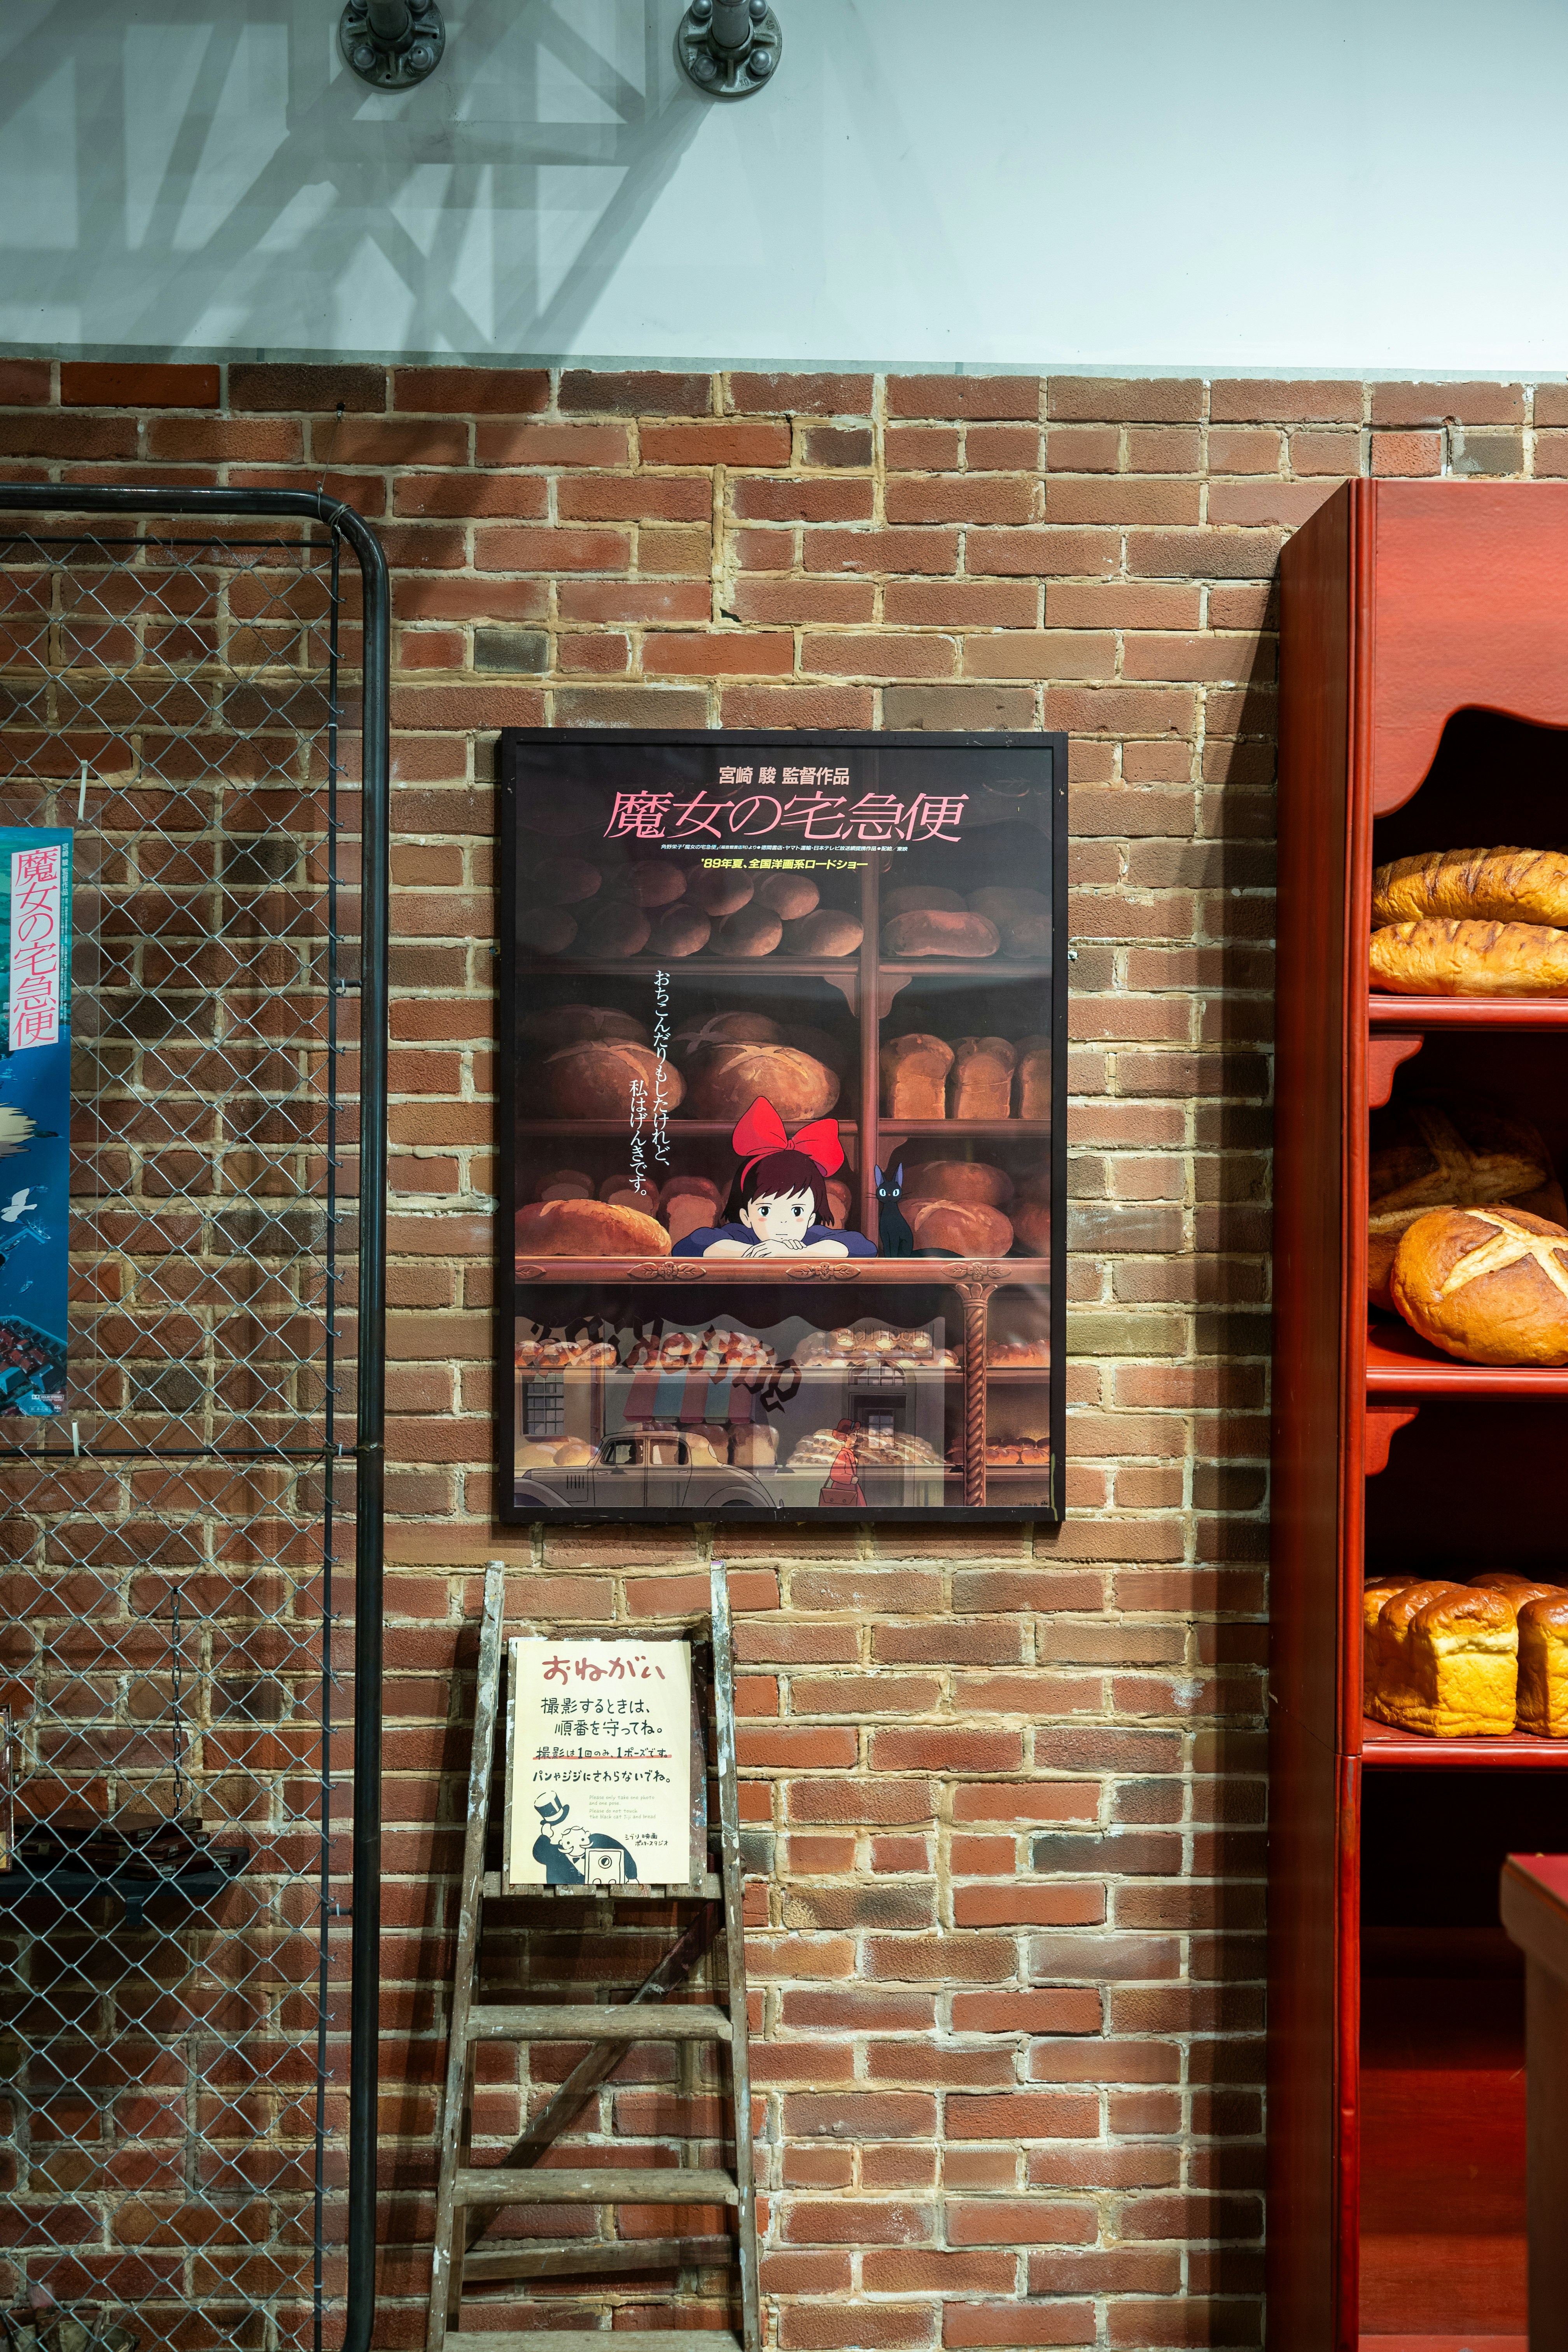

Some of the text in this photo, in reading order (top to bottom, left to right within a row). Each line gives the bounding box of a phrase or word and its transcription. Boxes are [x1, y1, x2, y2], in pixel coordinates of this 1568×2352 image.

[719, 766, 850, 785] 宮崎 駿 監督作品
[603, 790, 970, 842] 魔女の宅急便
[12, 848, 58, 1046] 魔女の宅急便
[651, 970, 671, 1166] おちこんだりもしたけれど、
[629, 1080, 649, 1196] 私はげんきです。
[542, 1655, 665, 1685] おねがい
[541, 1697, 650, 1715] 撮影するときは、
[555, 1718, 662, 1736] 順番を守ってね。
[533, 1770, 670, 1783] パンやジジにさわらないでね。
